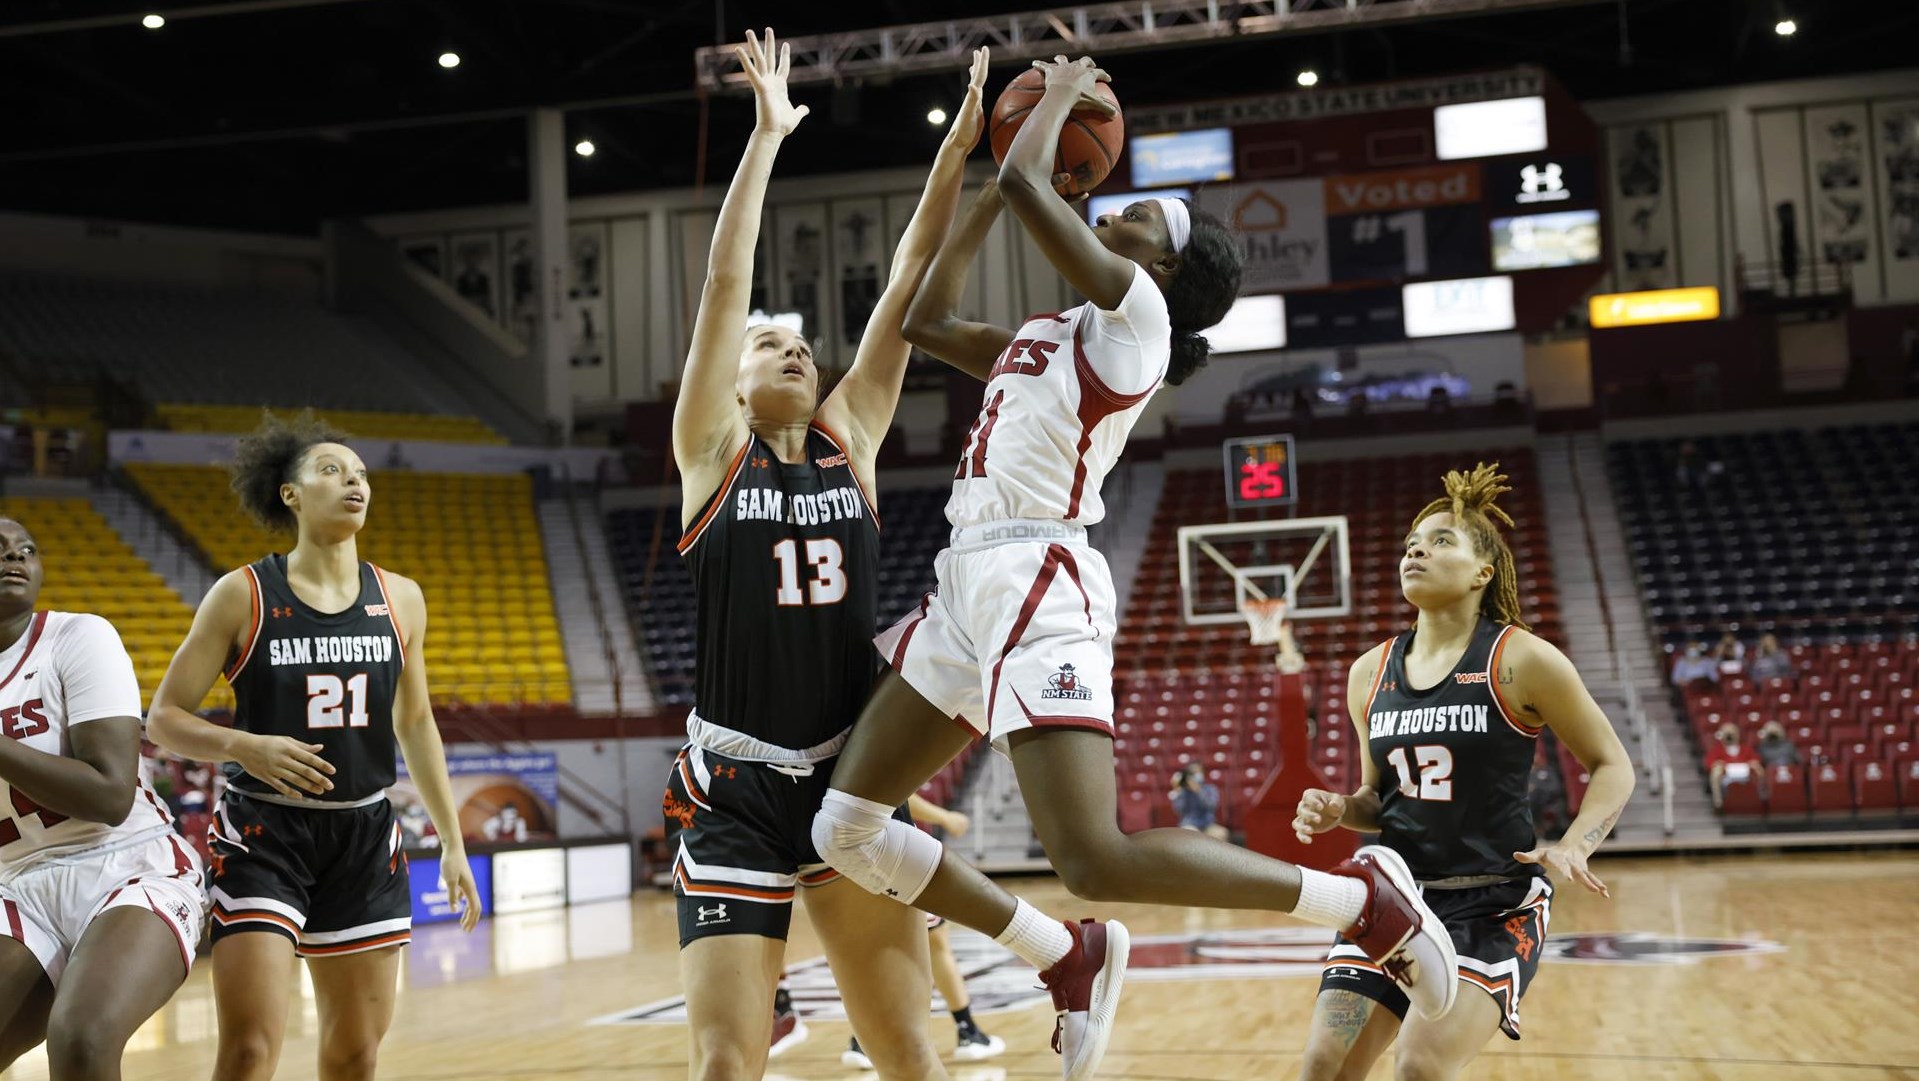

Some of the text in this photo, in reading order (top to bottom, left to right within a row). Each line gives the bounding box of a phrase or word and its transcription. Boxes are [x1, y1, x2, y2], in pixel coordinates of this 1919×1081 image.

[1300, 90, 1373, 110] STATE
[1335, 171, 1469, 208] Voted
[1247, 233, 1320, 266] hley
[1352, 209, 1429, 275] #1
[816, 453, 848, 469] WAC
[1241, 462, 1283, 500] 25
[737, 488, 783, 522] SAM
[772, 538, 848, 605] 13
[270, 635, 392, 666] SAM HOUSTON
[1041, 688, 1093, 700] NM STATE
[1455, 671, 1488, 684] WAC
[306, 673, 369, 729] 21
[1370, 704, 1489, 740] SAM HOUSTON
[1387, 745, 1453, 801] 12
